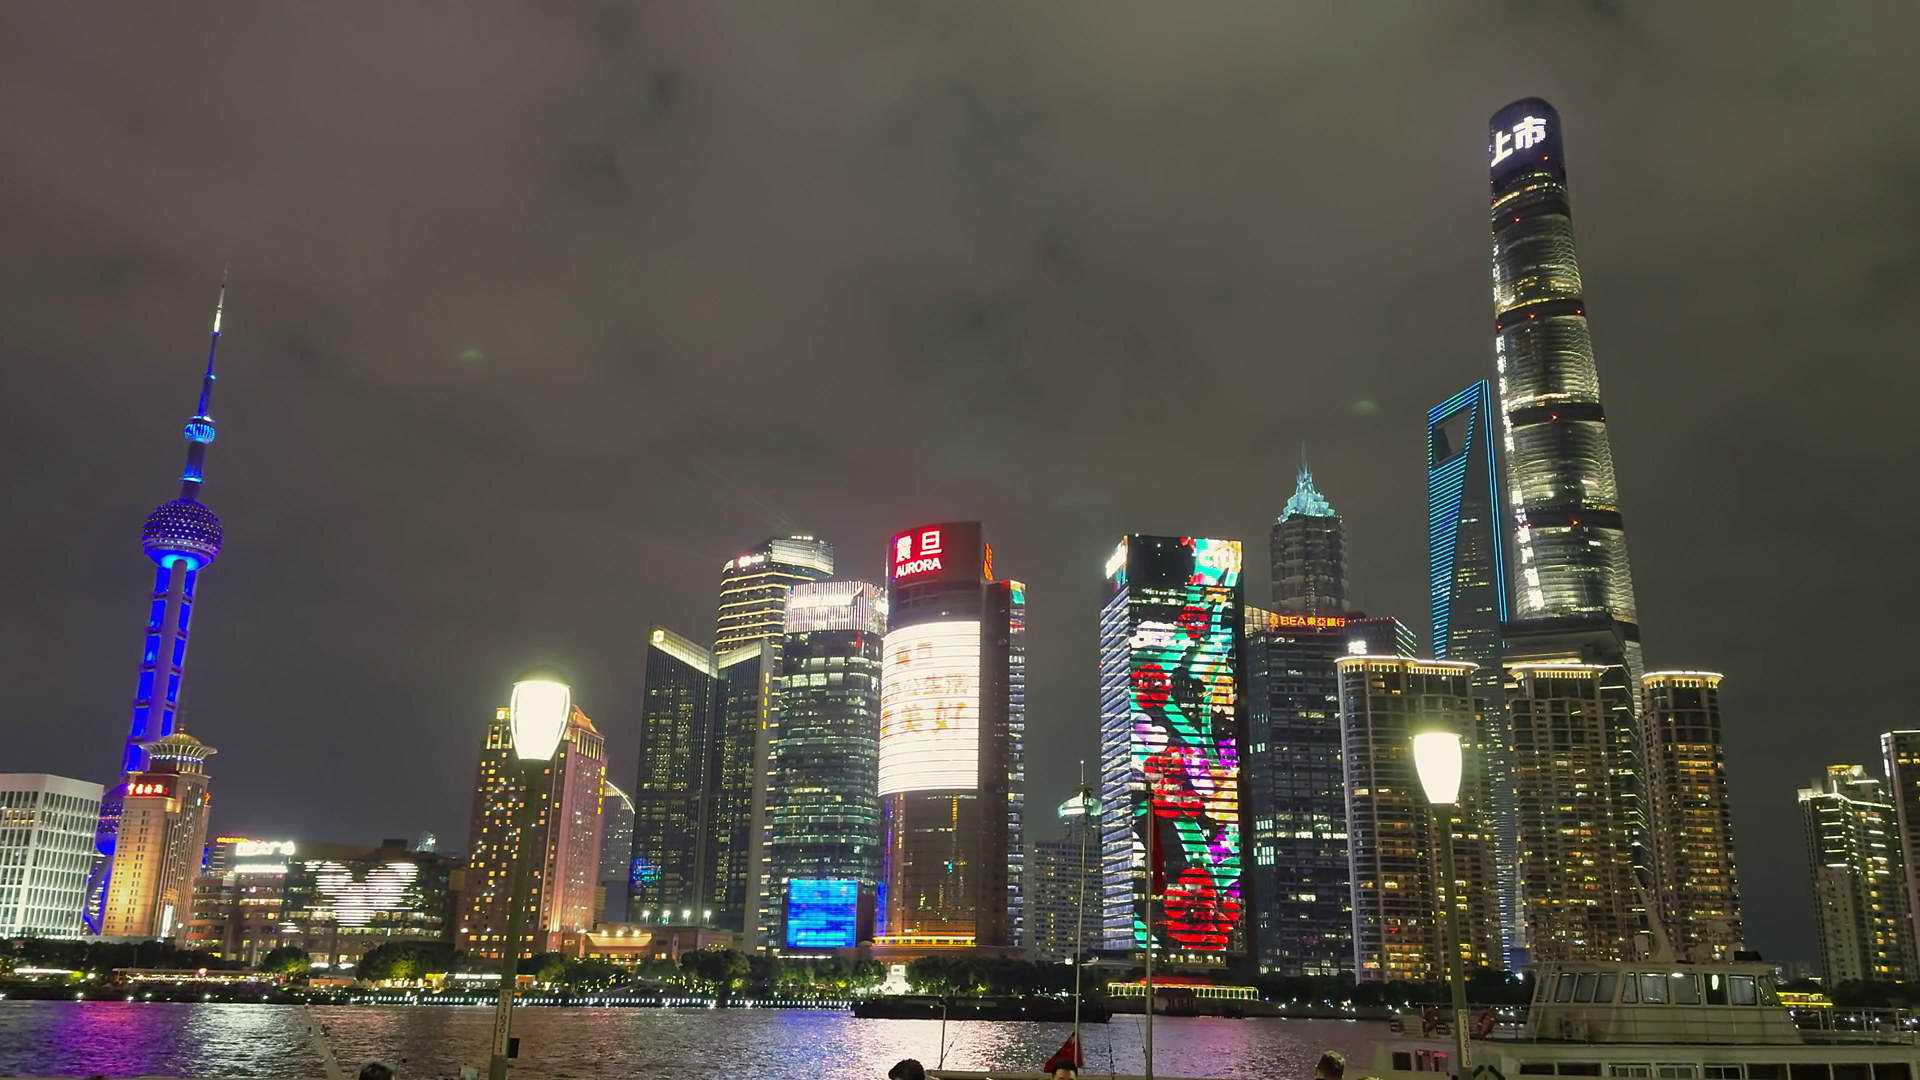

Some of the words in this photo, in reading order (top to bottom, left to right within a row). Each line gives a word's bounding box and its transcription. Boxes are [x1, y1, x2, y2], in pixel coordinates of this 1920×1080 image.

[1490, 115, 1547, 168] 上市
[896, 530, 943, 564] 震旦
[895, 557, 943, 579] AURORA
[1280, 615, 1306, 626] BEA
[1307, 616, 1346, 627] 東亞銀行
